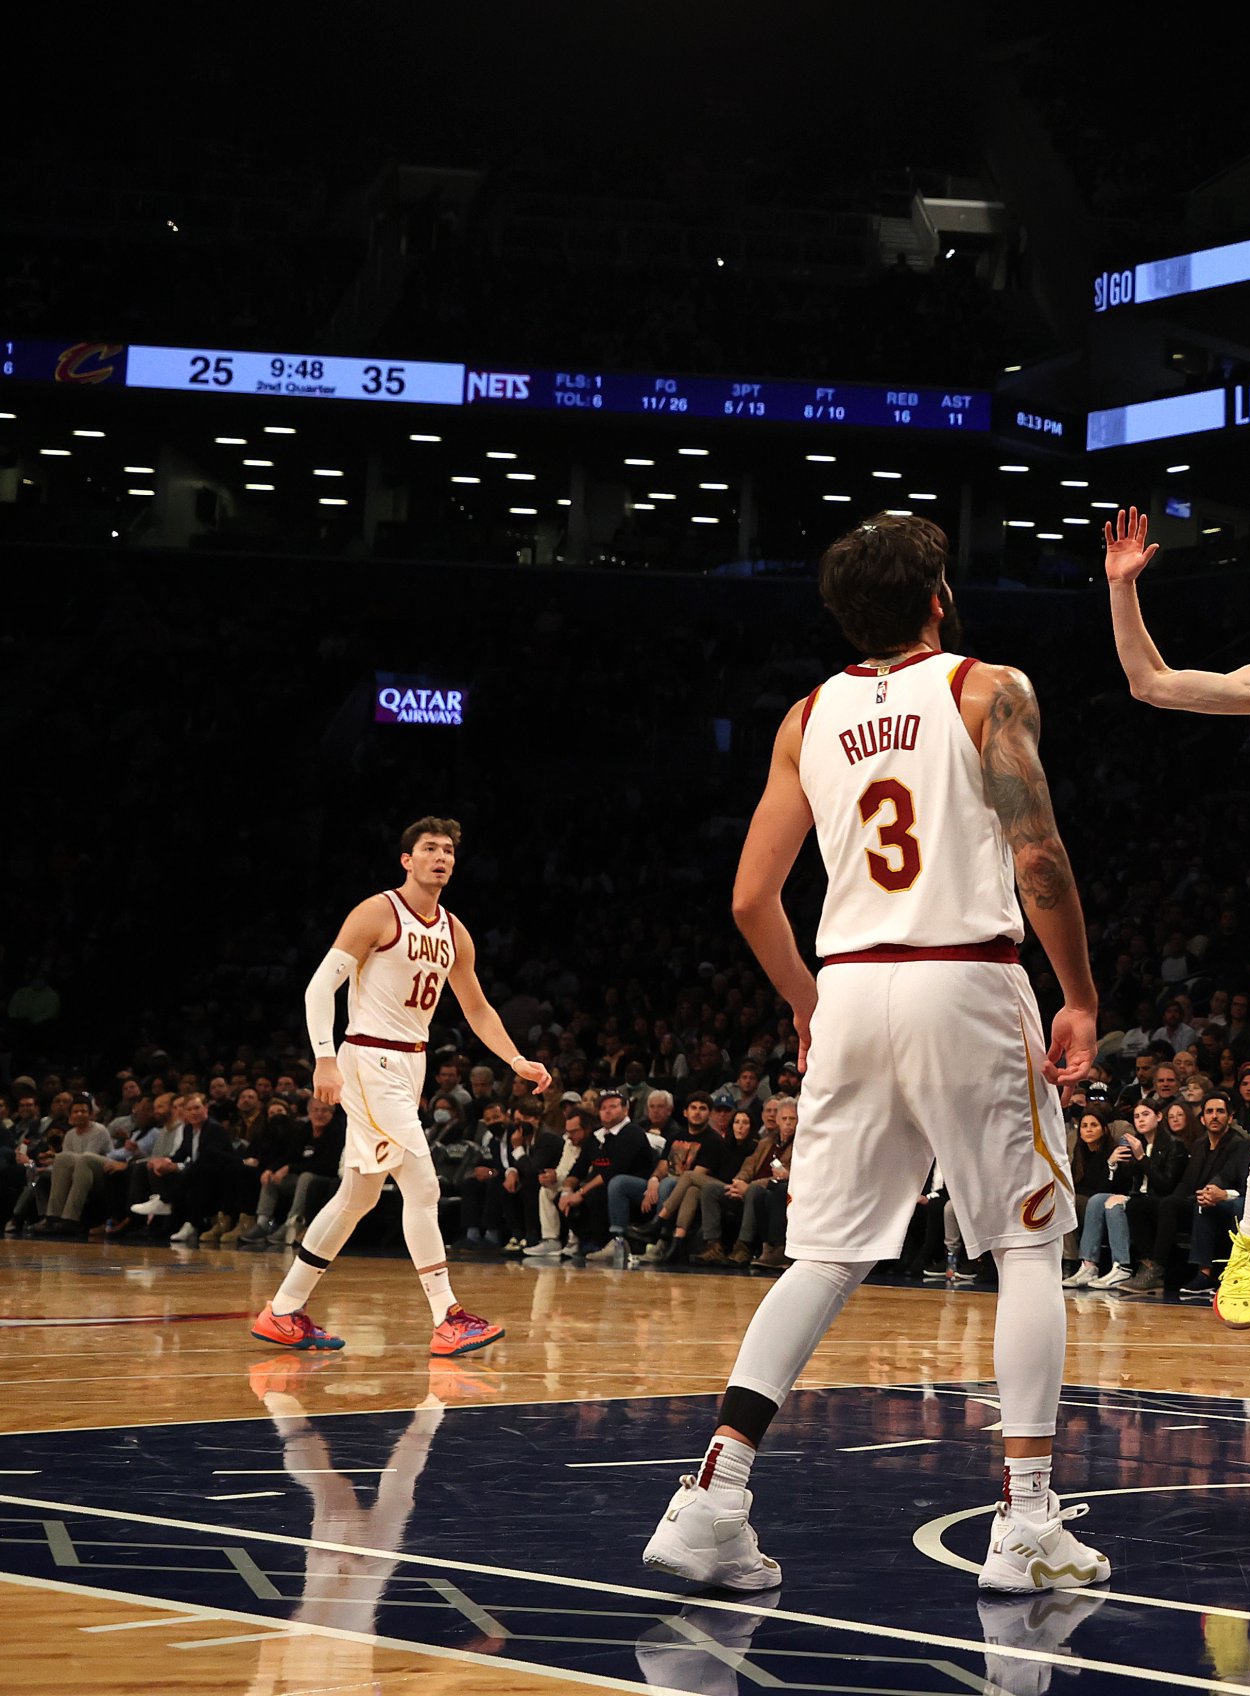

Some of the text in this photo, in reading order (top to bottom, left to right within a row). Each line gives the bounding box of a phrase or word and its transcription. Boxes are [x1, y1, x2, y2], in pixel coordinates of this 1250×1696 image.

[1110, 270, 1132, 305] GO
[6, 341, 13, 355] 1
[3, 361, 14, 375] 6
[188, 355, 234, 386] 25
[270, 357, 325, 380] 9:48
[255, 380, 337, 395] 2nd Quarter
[361, 365, 407, 396] 35
[467, 371, 532, 404] NETS
[655, 379, 677, 394] FG
[732, 383, 762, 398] 3PT
[815, 387, 836, 402] FT
[886, 391, 919, 407] REB
[940, 395, 973, 409] AST
[894, 410, 911, 424] 16
[948, 413, 963, 426] 11
[1016, 411, 1063, 437] 8:13 PM
[379, 688, 462, 713] QATAR
[396, 709, 463, 724] AIRWAYS
[838, 714, 921, 766] RUBIO
[857, 777, 922, 894] 3
[408, 931, 449, 969] CAVS
[404, 971, 439, 1011] 16
